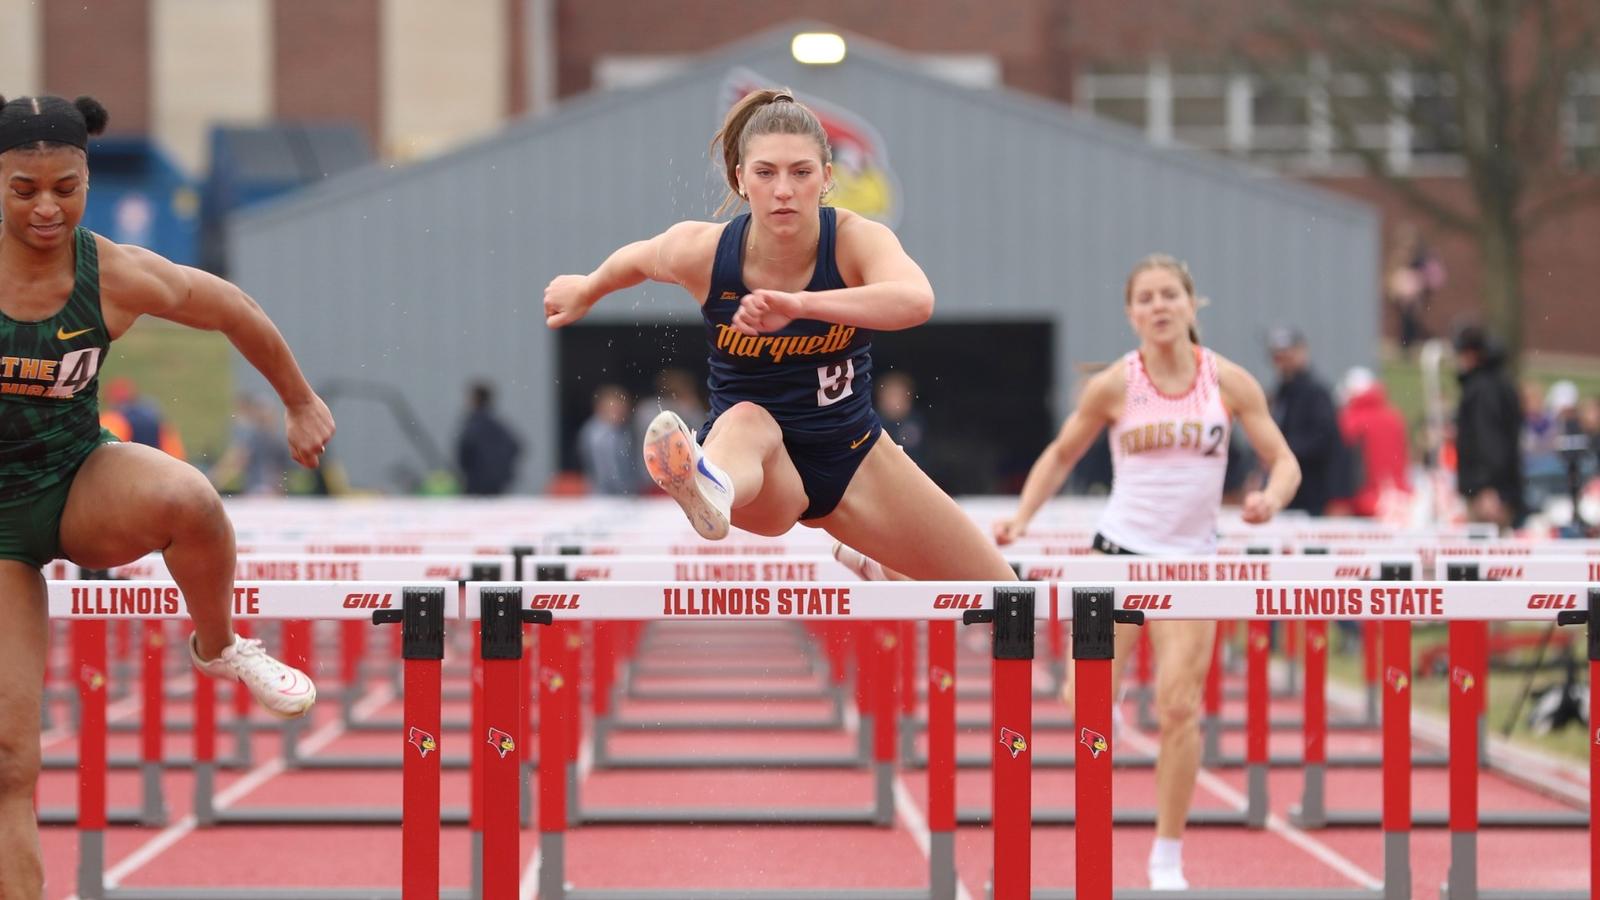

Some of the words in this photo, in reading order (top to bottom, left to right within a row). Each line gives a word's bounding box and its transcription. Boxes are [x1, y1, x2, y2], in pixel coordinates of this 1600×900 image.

[716, 323, 856, 363] Marquette
[62, 350, 93, 390] 4
[823, 359, 849, 399] 3
[1204, 425, 1223, 456] 2
[306, 563, 358, 580] STATE
[676, 563, 756, 580] ILLINOIS
[763, 563, 815, 580] STATE
[1129, 563, 1209, 580] ILLINOIS
[1216, 563, 1269, 580] STATE
[72, 588, 179, 614] ILLINOIS
[343, 593, 391, 608] GILL
[530, 594, 579, 609] GILL
[663, 588, 770, 615] ILLINOIS
[777, 588, 849, 615] STATE
[934, 593, 982, 608] GILL
[1123, 594, 1172, 609] GILL
[1256, 588, 1363, 615] ILLINOIS
[1370, 588, 1442, 615] STATE
[1527, 594, 1576, 609] GILL
